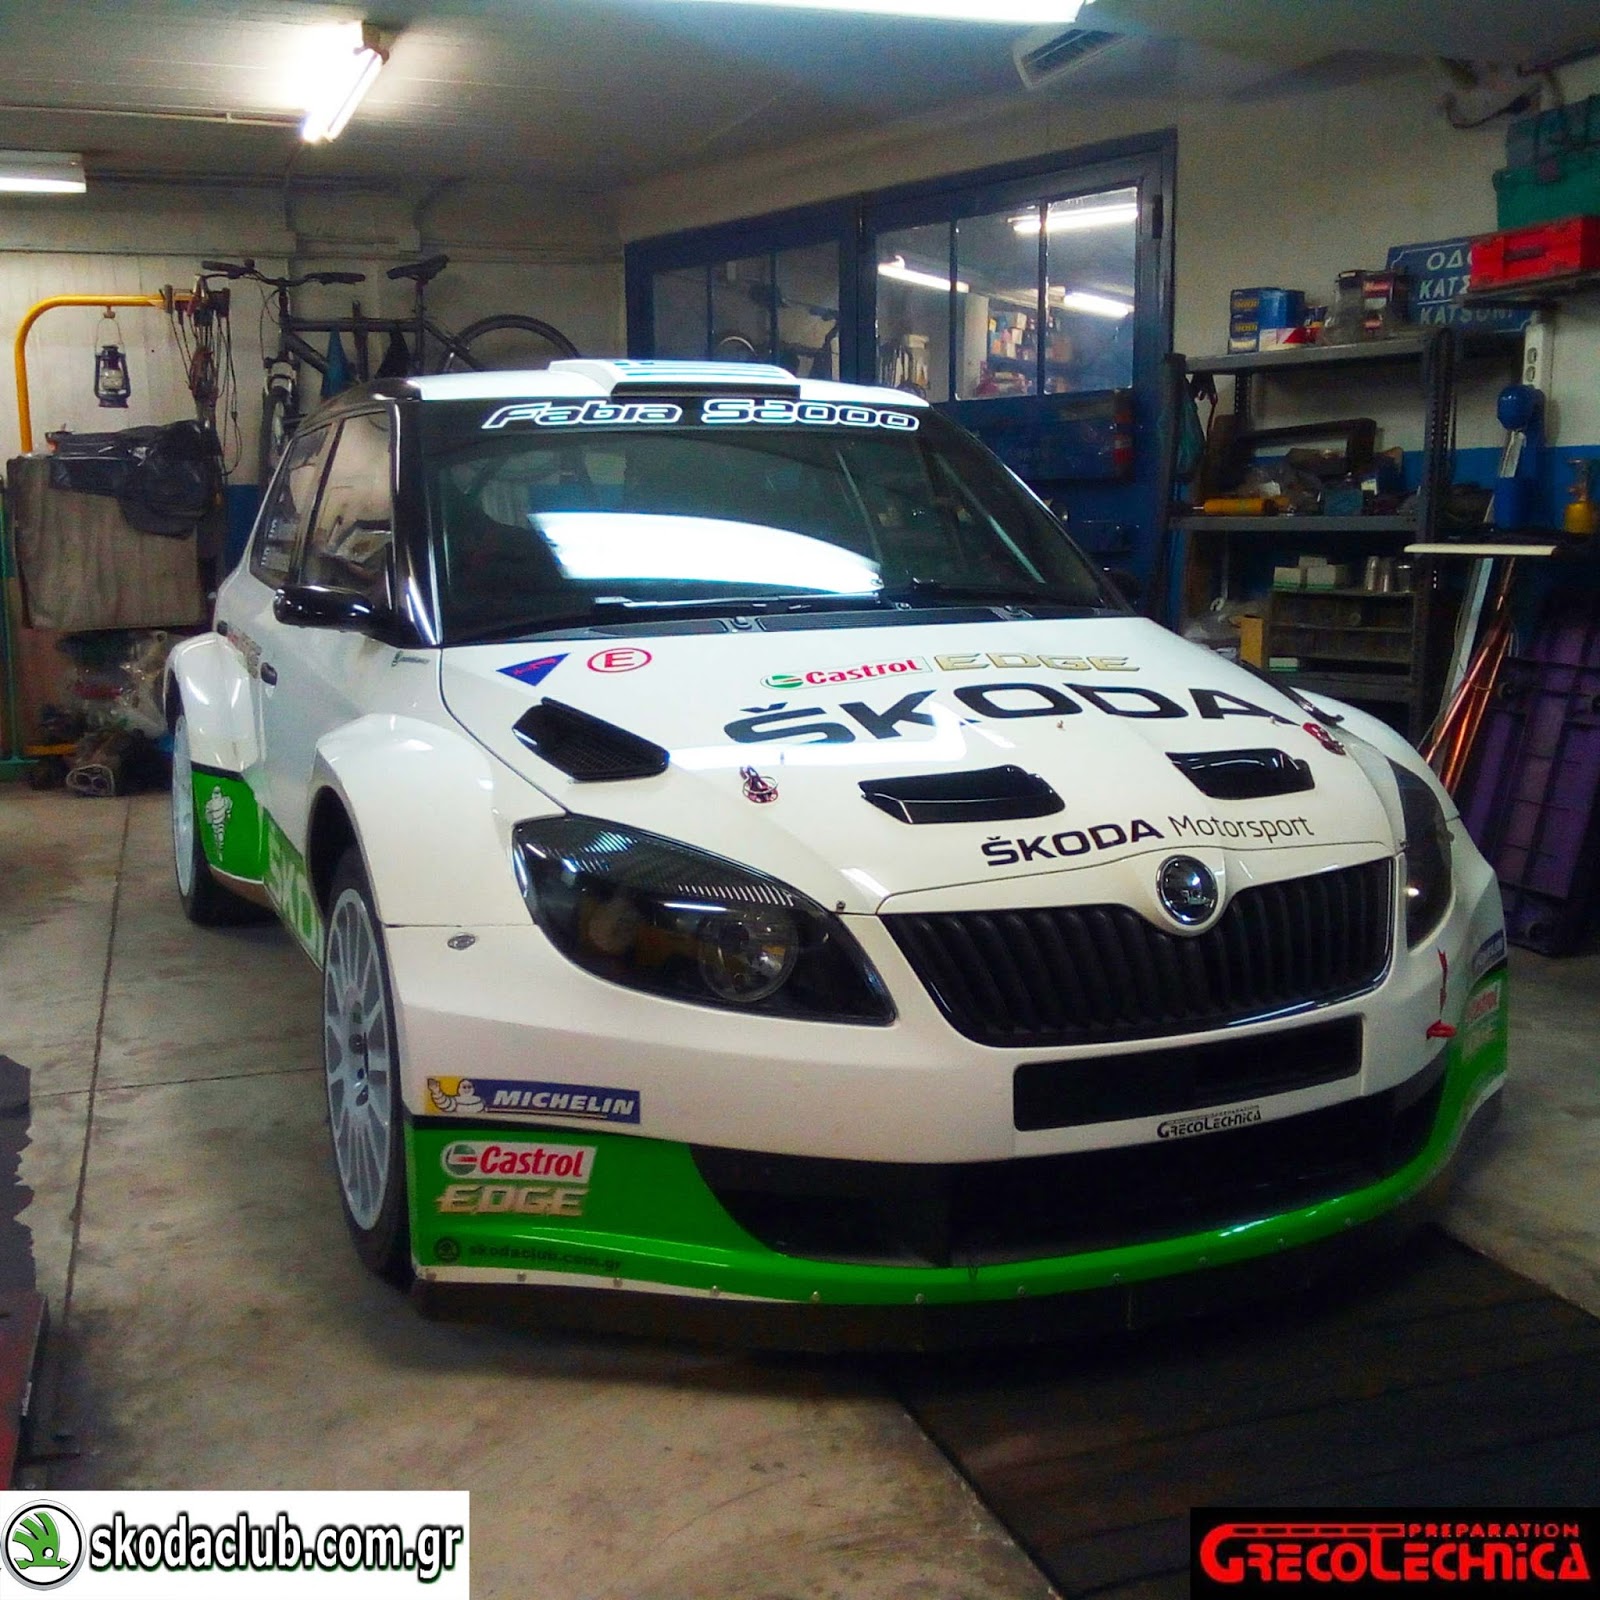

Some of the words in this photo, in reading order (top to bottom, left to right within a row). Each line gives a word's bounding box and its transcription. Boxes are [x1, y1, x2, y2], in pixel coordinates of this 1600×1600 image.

[481, 400, 682, 429] Fabia
[701, 399, 921, 431] S2000
[805, 658, 922, 685] Castrol
[934, 653, 1140, 671] EDGE
[724, 682, 1301, 744] ŠKODA
[981, 819, 1165, 867] ŠKODA
[1168, 815, 1315, 843] Motorsport
[493, 1090, 634, 1115] MICHELIN
[480, 1146, 584, 1177] Castrol
[436, 1184, 588, 1216] EDGE
